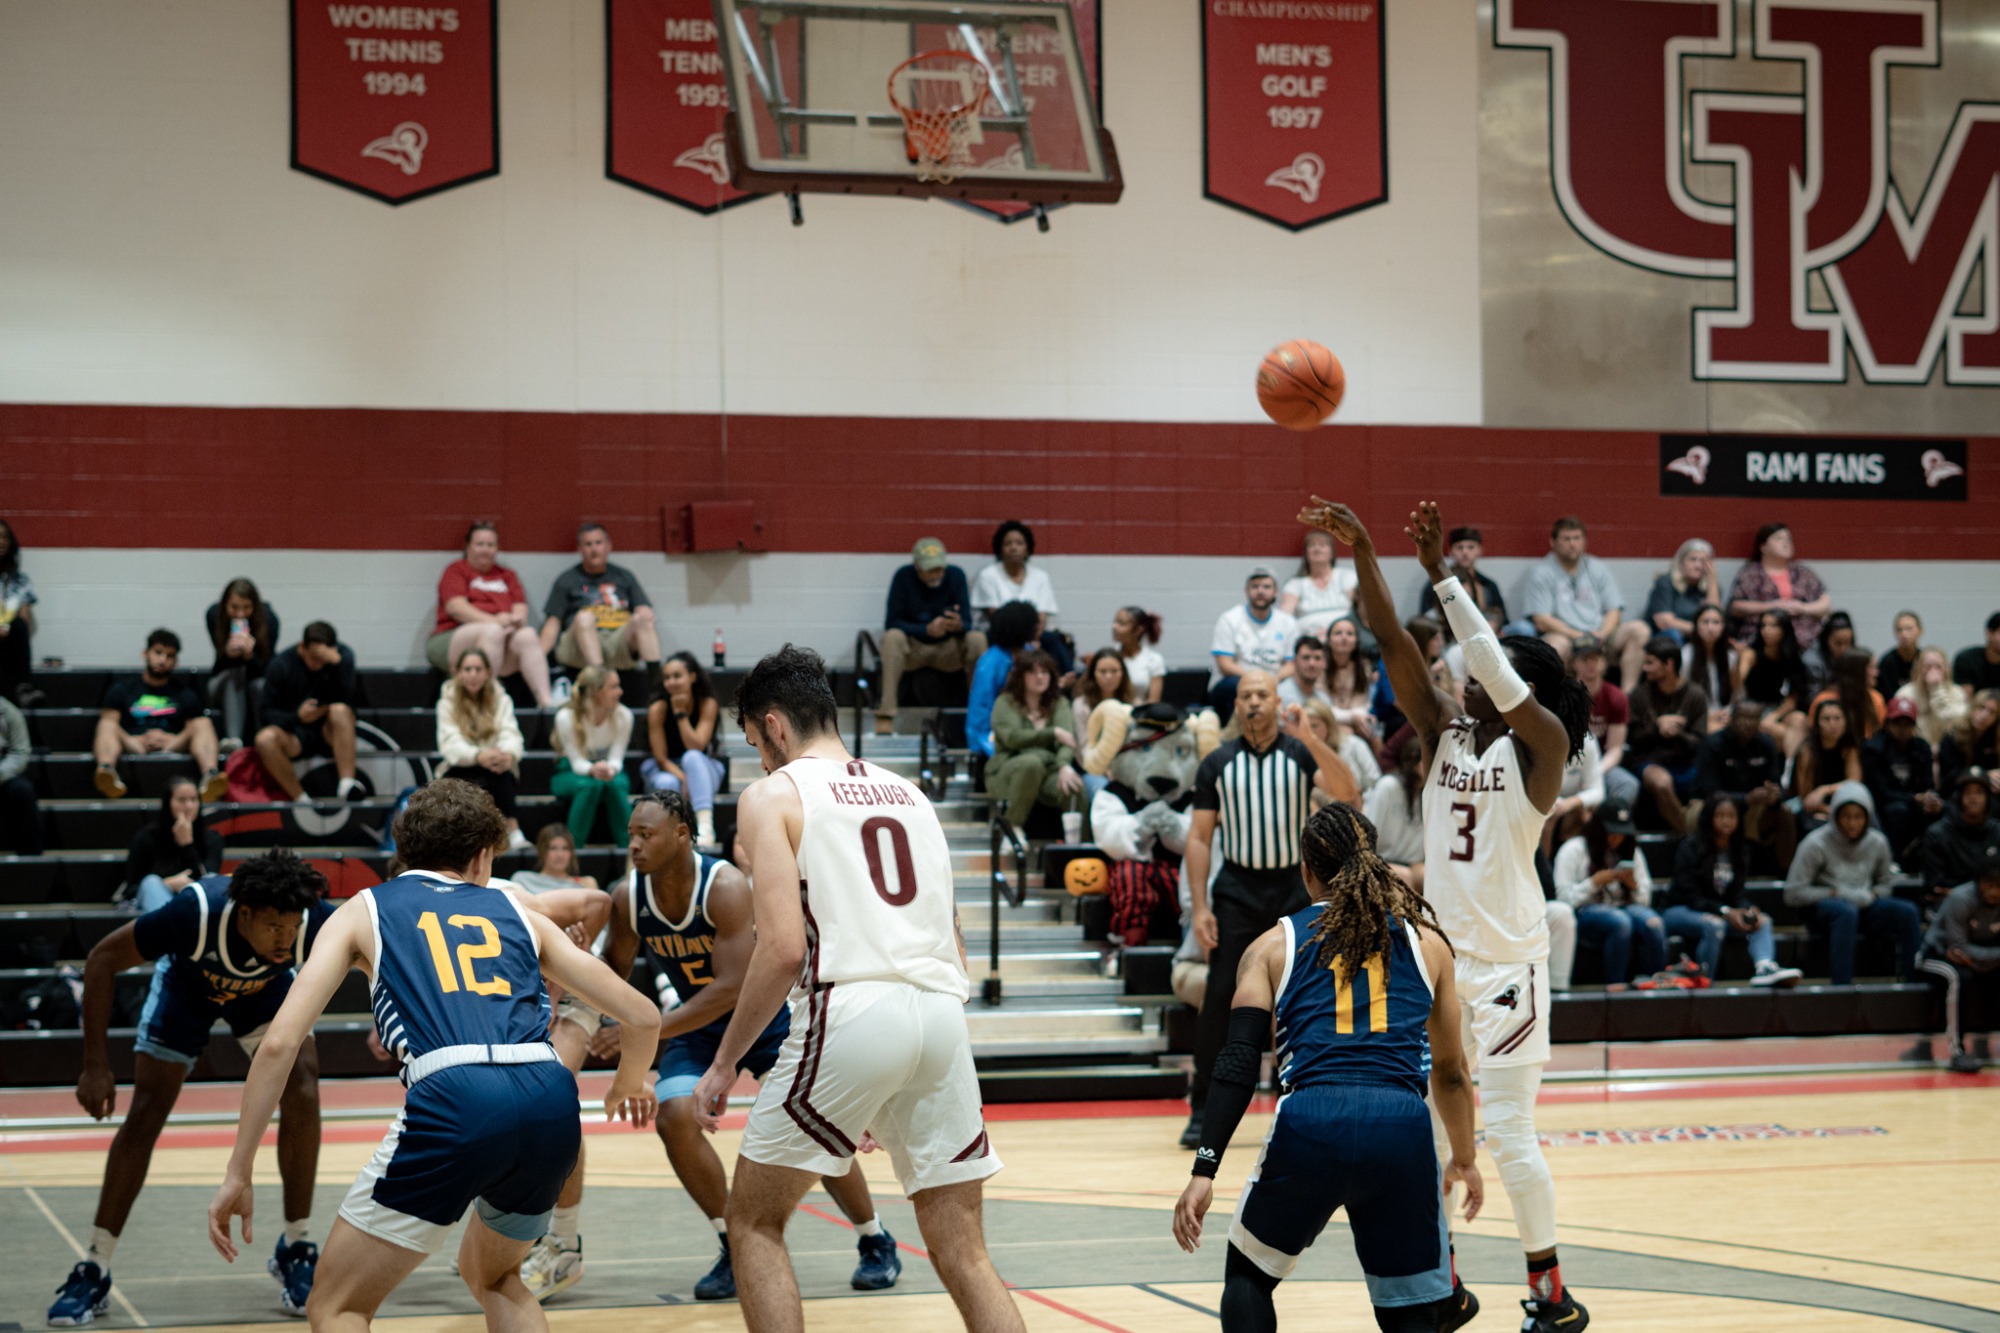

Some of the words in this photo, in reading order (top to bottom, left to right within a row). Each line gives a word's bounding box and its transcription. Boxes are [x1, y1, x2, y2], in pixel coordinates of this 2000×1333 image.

[327, 5, 459, 32] WOMEN'S
[1213, 1, 1373, 21] CHAMPIONSHIP
[664, 18, 719, 42] MEN
[345, 38, 444, 64] TENNIS
[658, 50, 724, 74] TENN
[1256, 44, 1332, 67] MEN'S
[362, 71, 427, 96] 1994
[1261, 75, 1327, 98] GOLF
[1267, 106, 1323, 129] 1997
[1747, 451, 1809, 482] RAM
[1815, 453, 1886, 484] FANS
[1436, 760, 1506, 792] MOBILE
[828, 781, 916, 807] KEEBAUGH
[1448, 803, 1476, 862] 3
[860, 816, 918, 907] 0
[416, 911, 512, 996] 12
[1327, 950, 1388, 1034] 11
